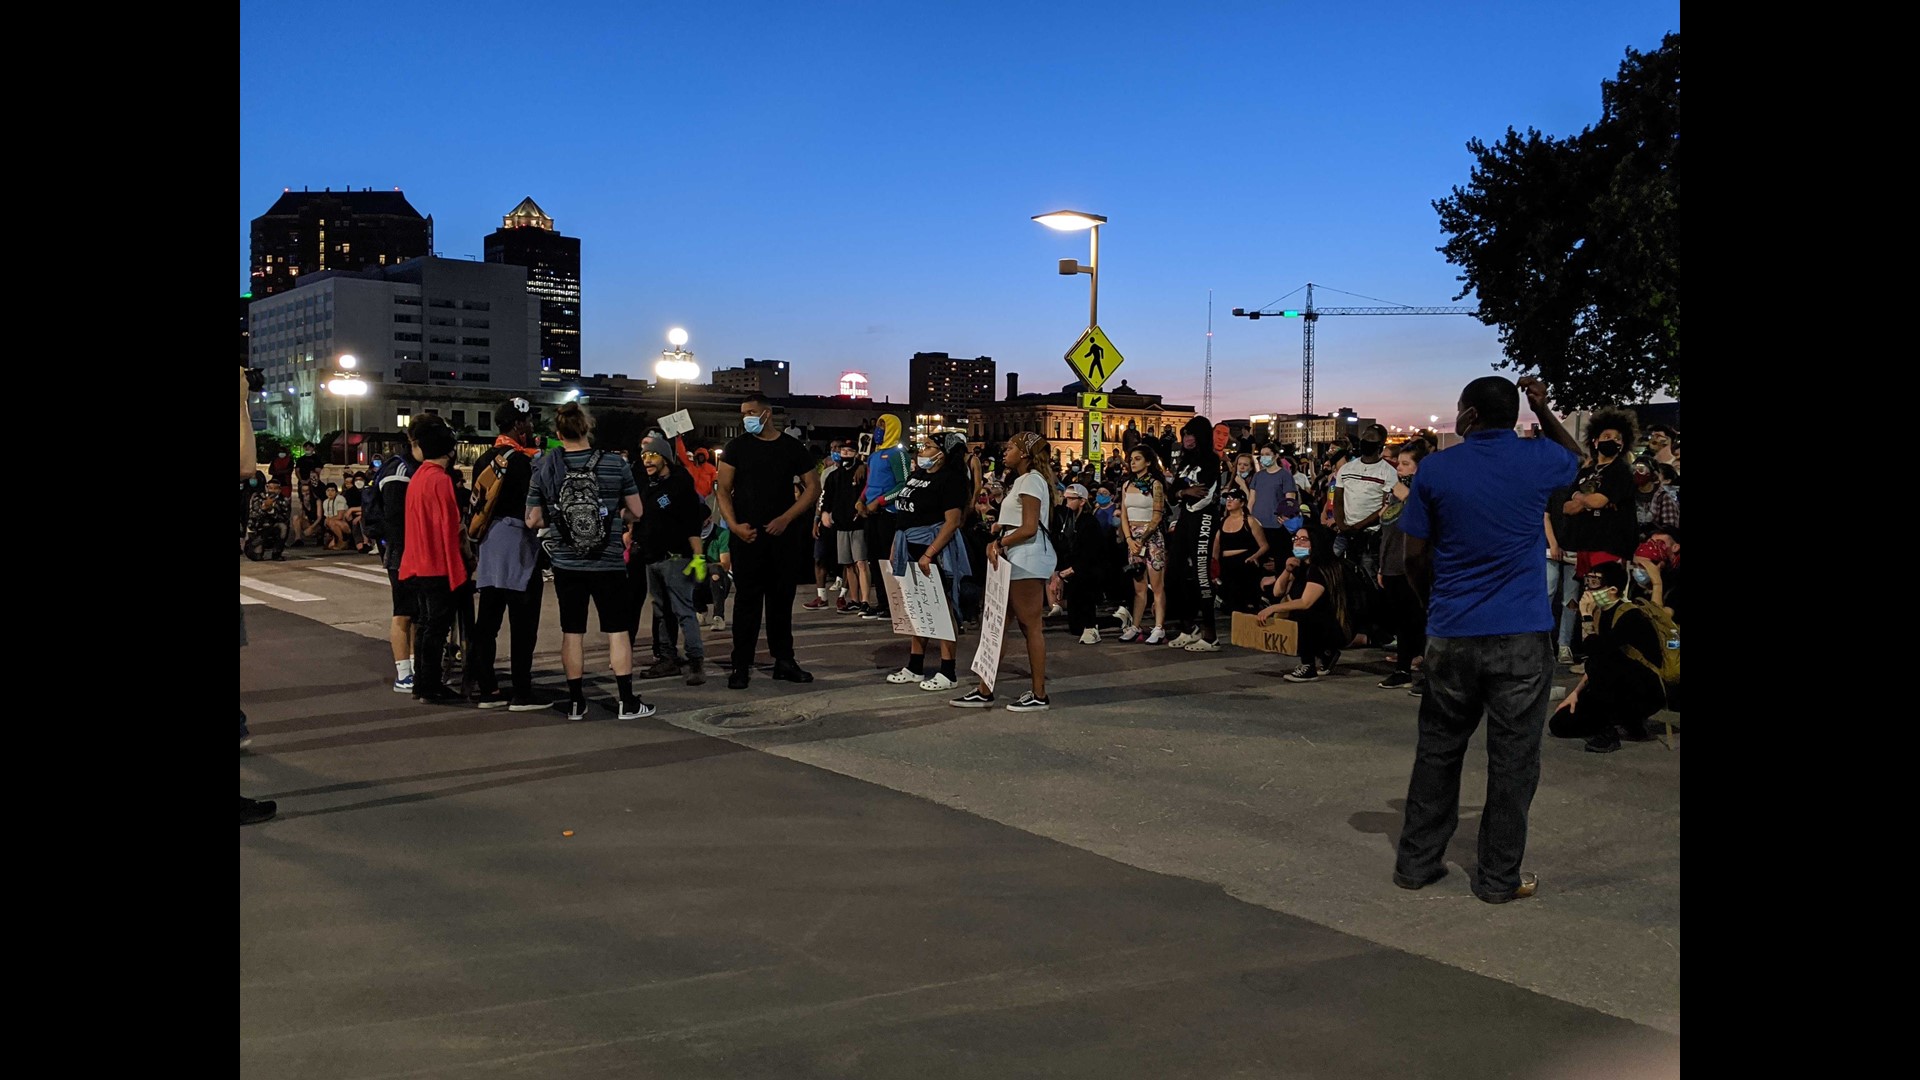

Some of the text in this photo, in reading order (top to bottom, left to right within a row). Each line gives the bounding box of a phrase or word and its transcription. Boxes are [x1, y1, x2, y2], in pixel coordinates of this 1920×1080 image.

[1199, 513, 1213, 538] ROCK
[1197, 539, 1209, 555] THE
[1197, 556, 1210, 588] RUNWAY
[926, 611, 936, 636] NEVER
[1264, 632, 1288, 653] KKK
